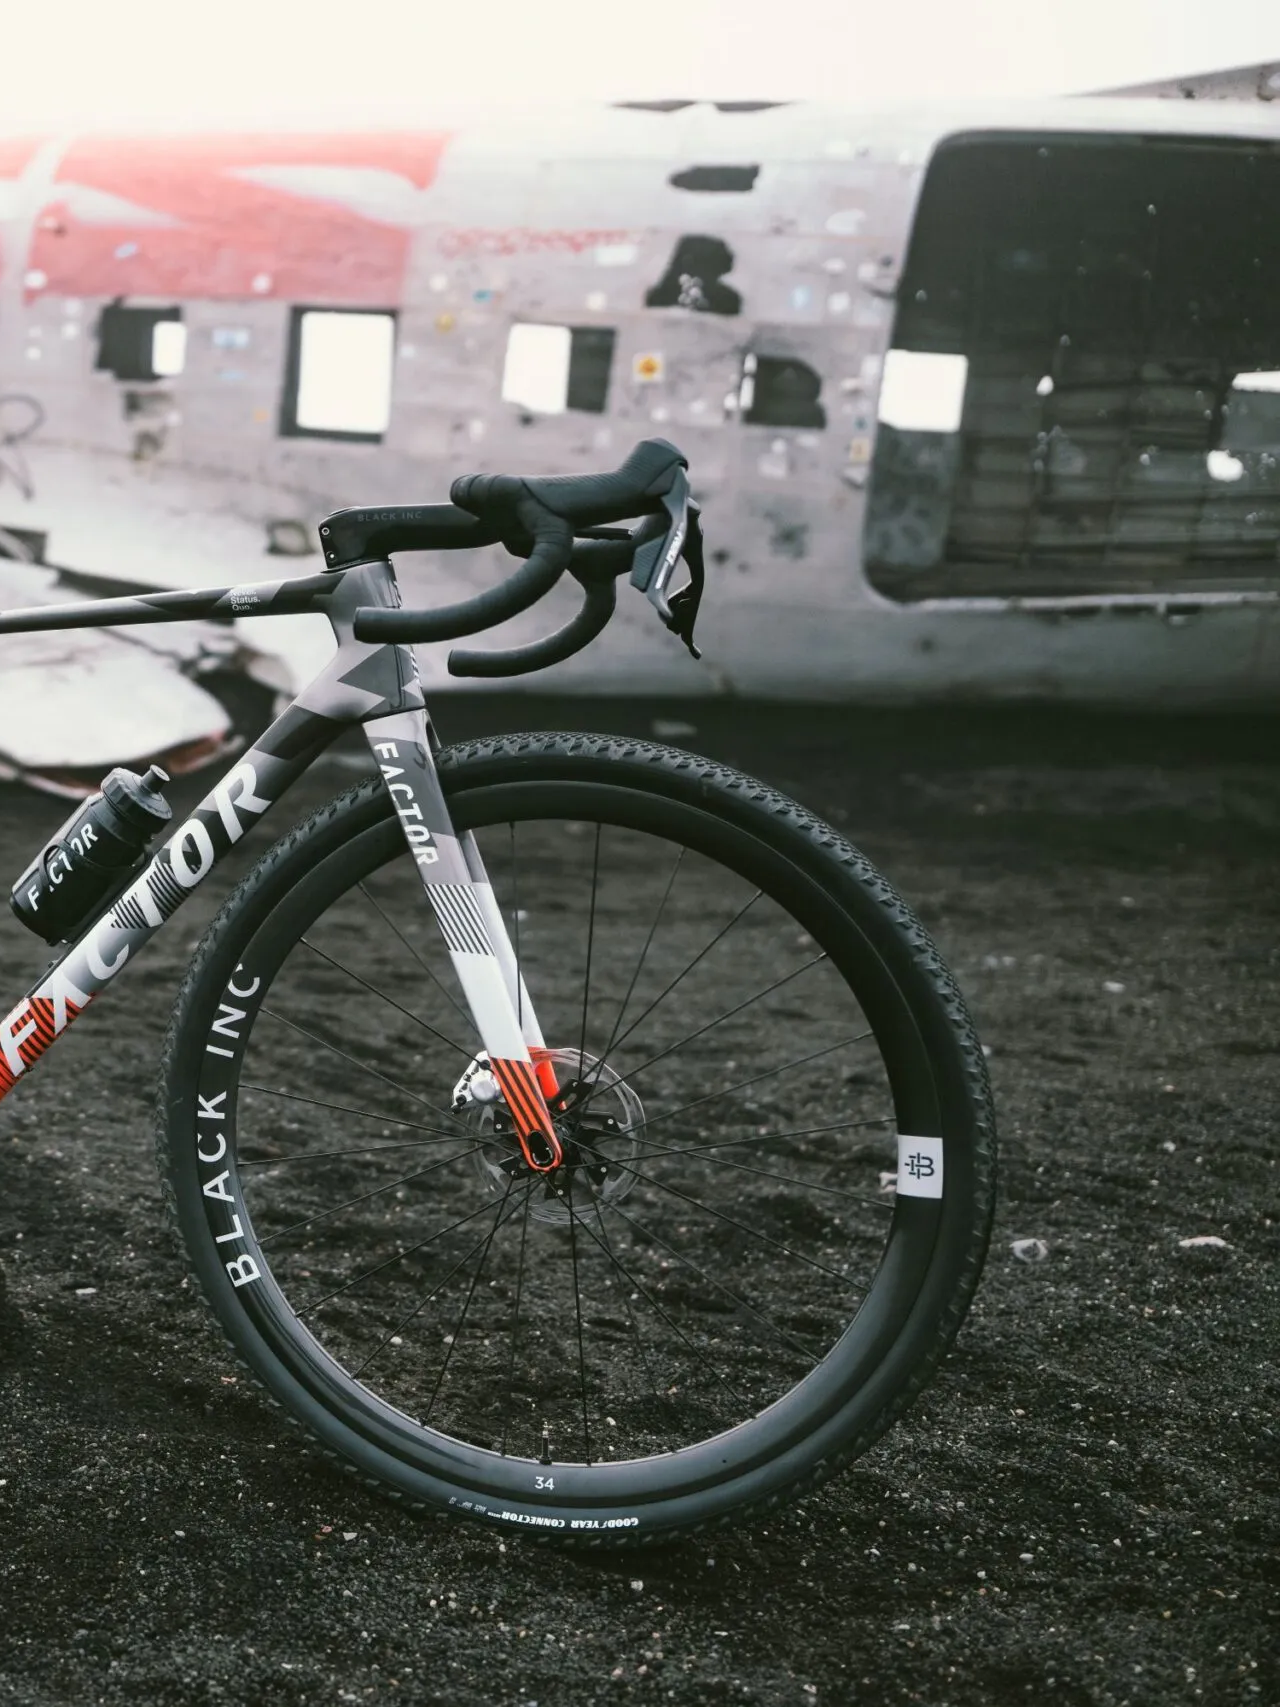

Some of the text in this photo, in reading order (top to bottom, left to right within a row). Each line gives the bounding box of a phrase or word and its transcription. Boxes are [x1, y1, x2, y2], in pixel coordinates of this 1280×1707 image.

[357, 510, 423, 522] BLACK INC
[373, 741, 440, 865] FACTOR
[27, 823, 99, 912] FCTOR
[196, 963, 262, 1288] BLACK INC
[534, 1476, 555, 1491] 34
[501, 1510, 566, 1528] CONNECTOR
